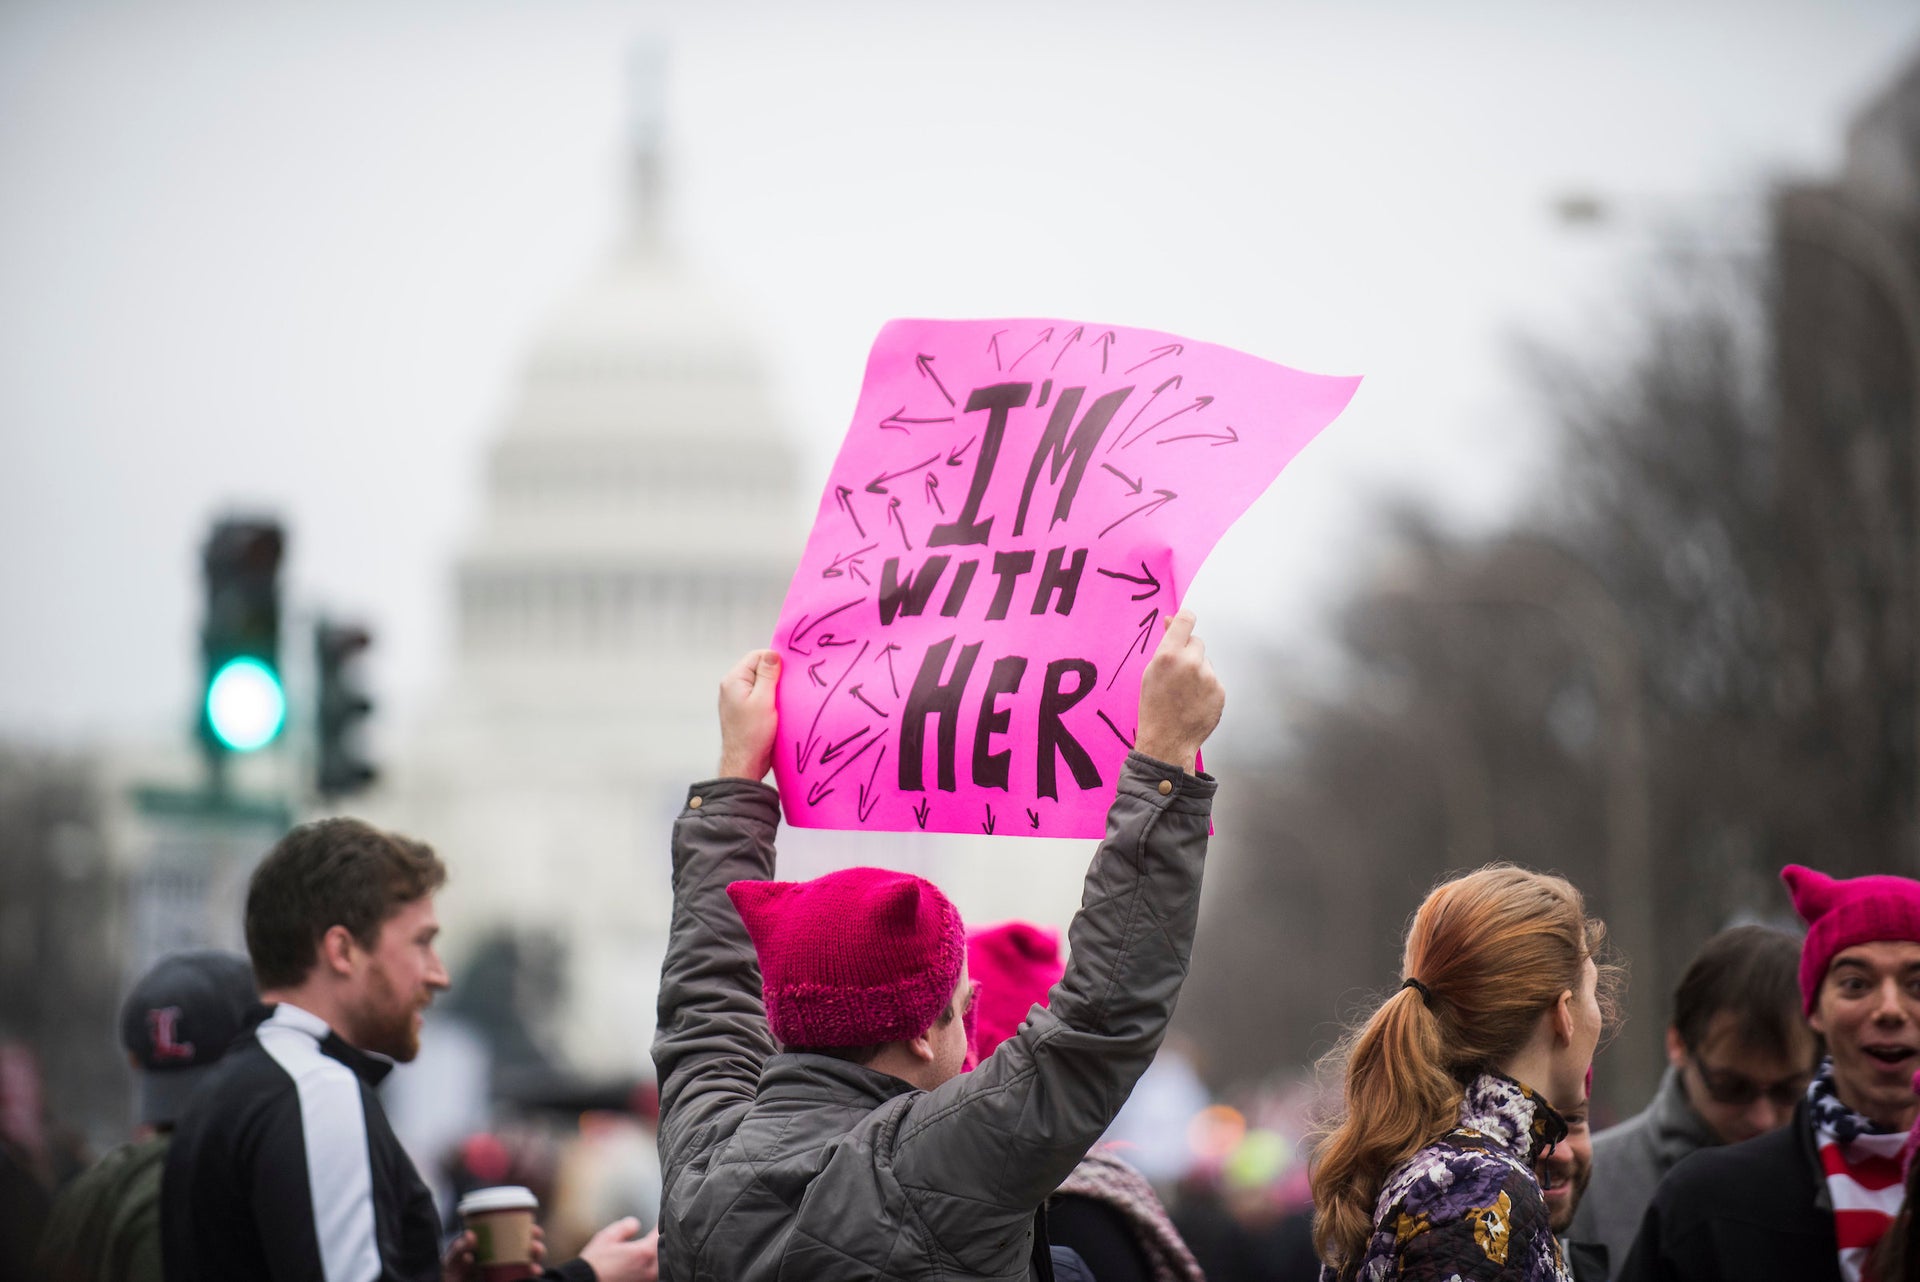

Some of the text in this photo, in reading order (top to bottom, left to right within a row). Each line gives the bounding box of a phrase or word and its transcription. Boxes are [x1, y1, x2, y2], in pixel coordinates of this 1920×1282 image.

[926, 379, 1136, 548] I'M
[878, 546, 1088, 626] WITH
[898, 635, 1103, 801] HER
[147, 1006, 195, 1060] L
